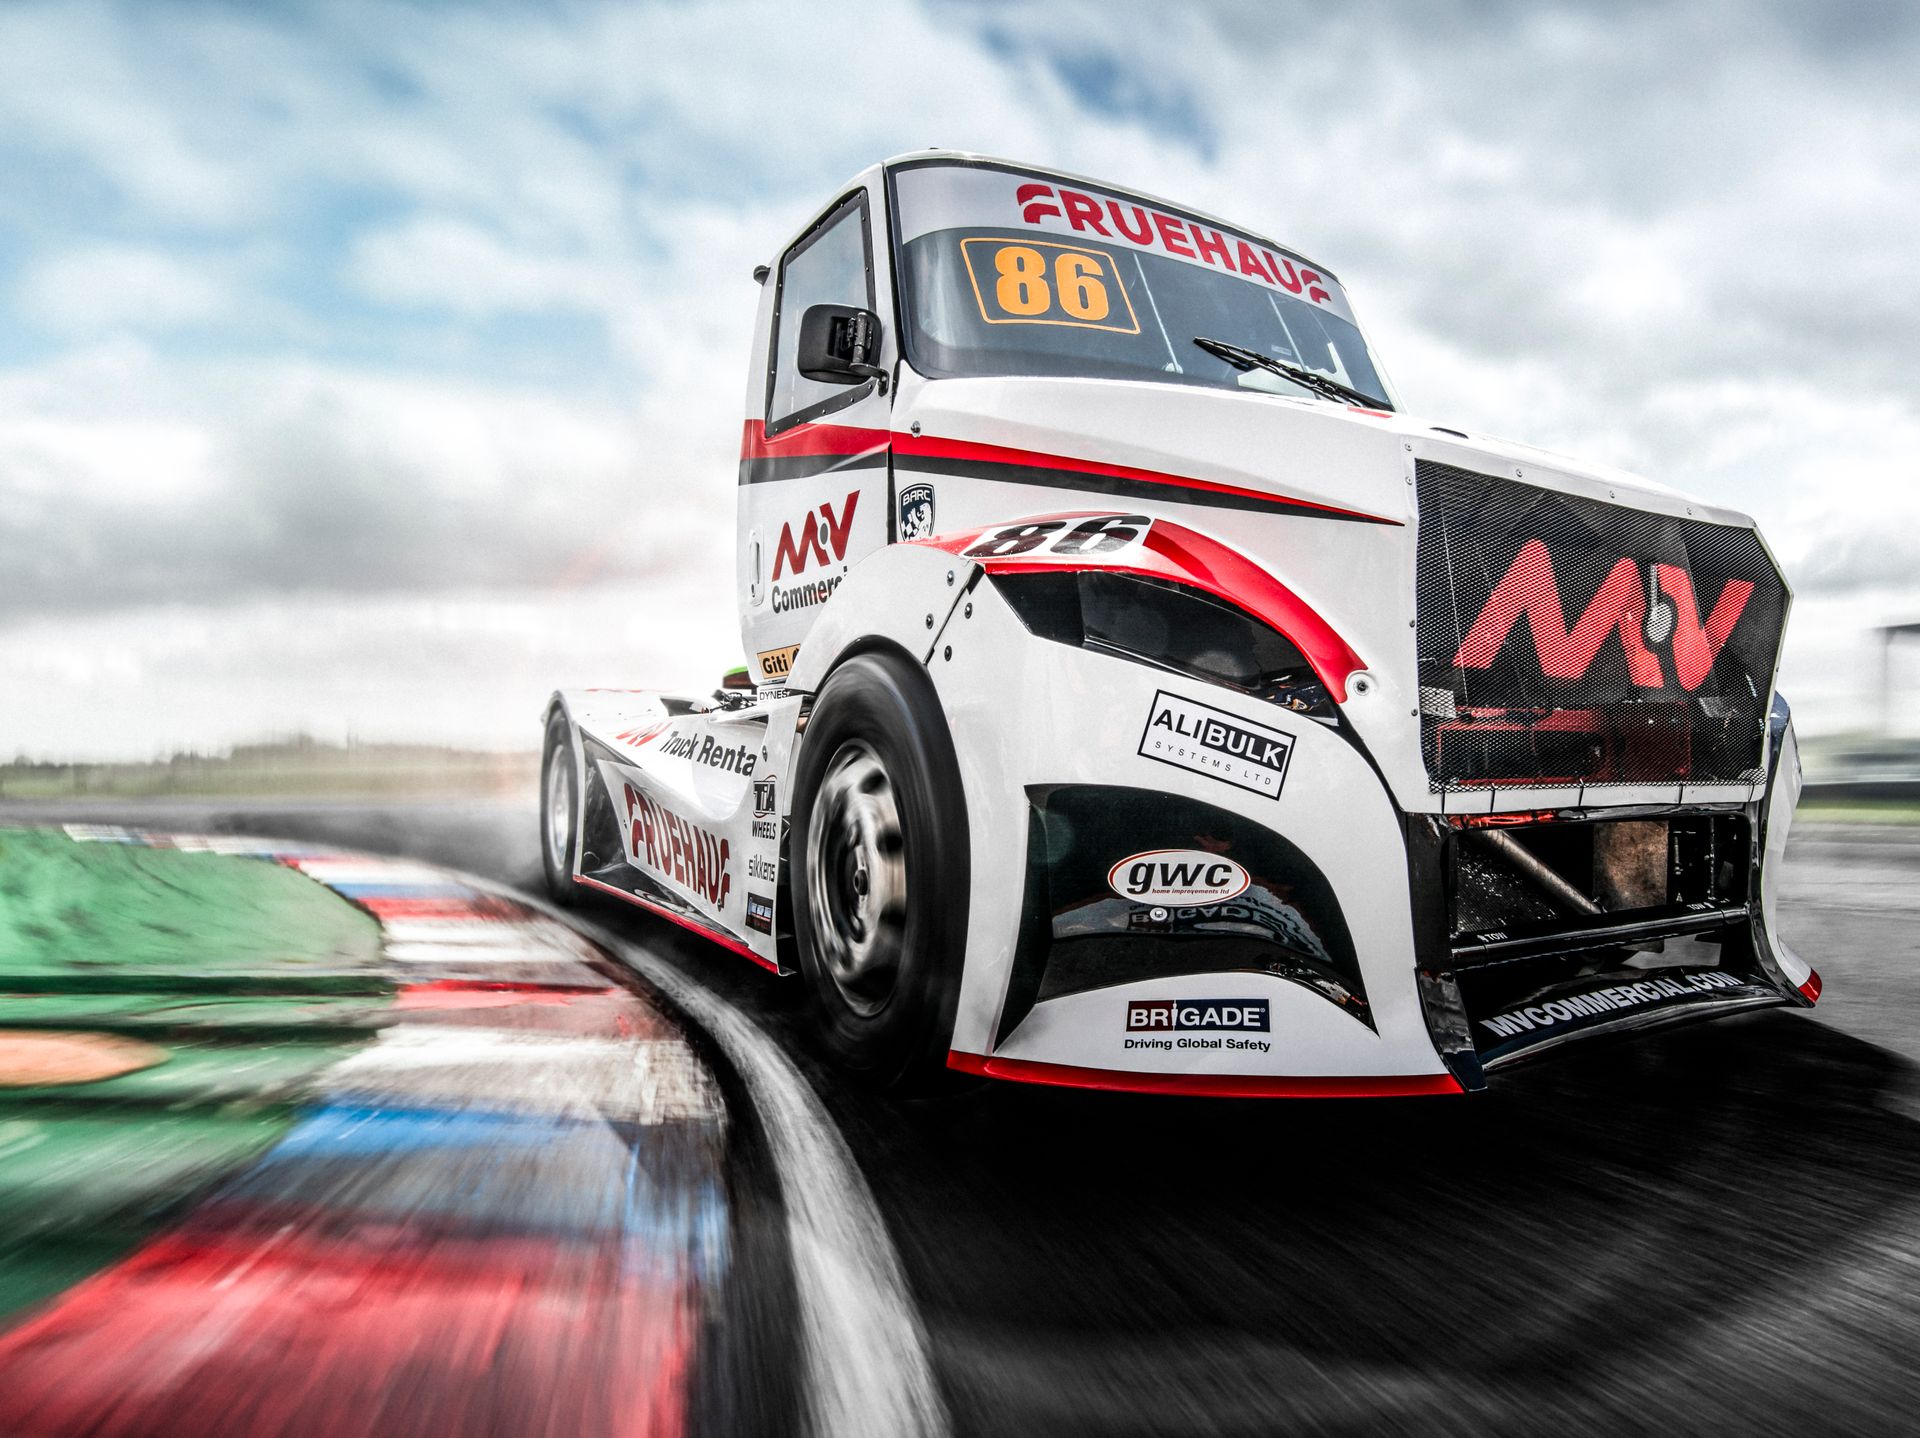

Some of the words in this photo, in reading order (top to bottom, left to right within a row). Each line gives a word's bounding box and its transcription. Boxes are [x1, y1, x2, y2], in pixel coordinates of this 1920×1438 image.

[994, 246, 1109, 321] 86
[902, 489, 931, 507] BARC
[772, 489, 860, 582] MV
[963, 515, 1151, 557] 86
[771, 565, 848, 614] Commer
[1453, 538, 1755, 692] MV
[762, 653, 789, 674] Giti
[659, 731, 700, 760] Truck
[1153, 709, 1284, 768] ALIBULK
[1155, 741, 1231, 771] SYSTEMS
[1244, 770, 1271, 785] LTD
[752, 820, 777, 840] WHEELS
[1127, 862, 1232, 895] gwc
[1479, 971, 1745, 1037] MVCOMMERCIAL.COM
[1124, 1038, 1173, 1050] Driving
[1177, 1038, 1222, 1049] Global
[1226, 1038, 1271, 1053] Safety
